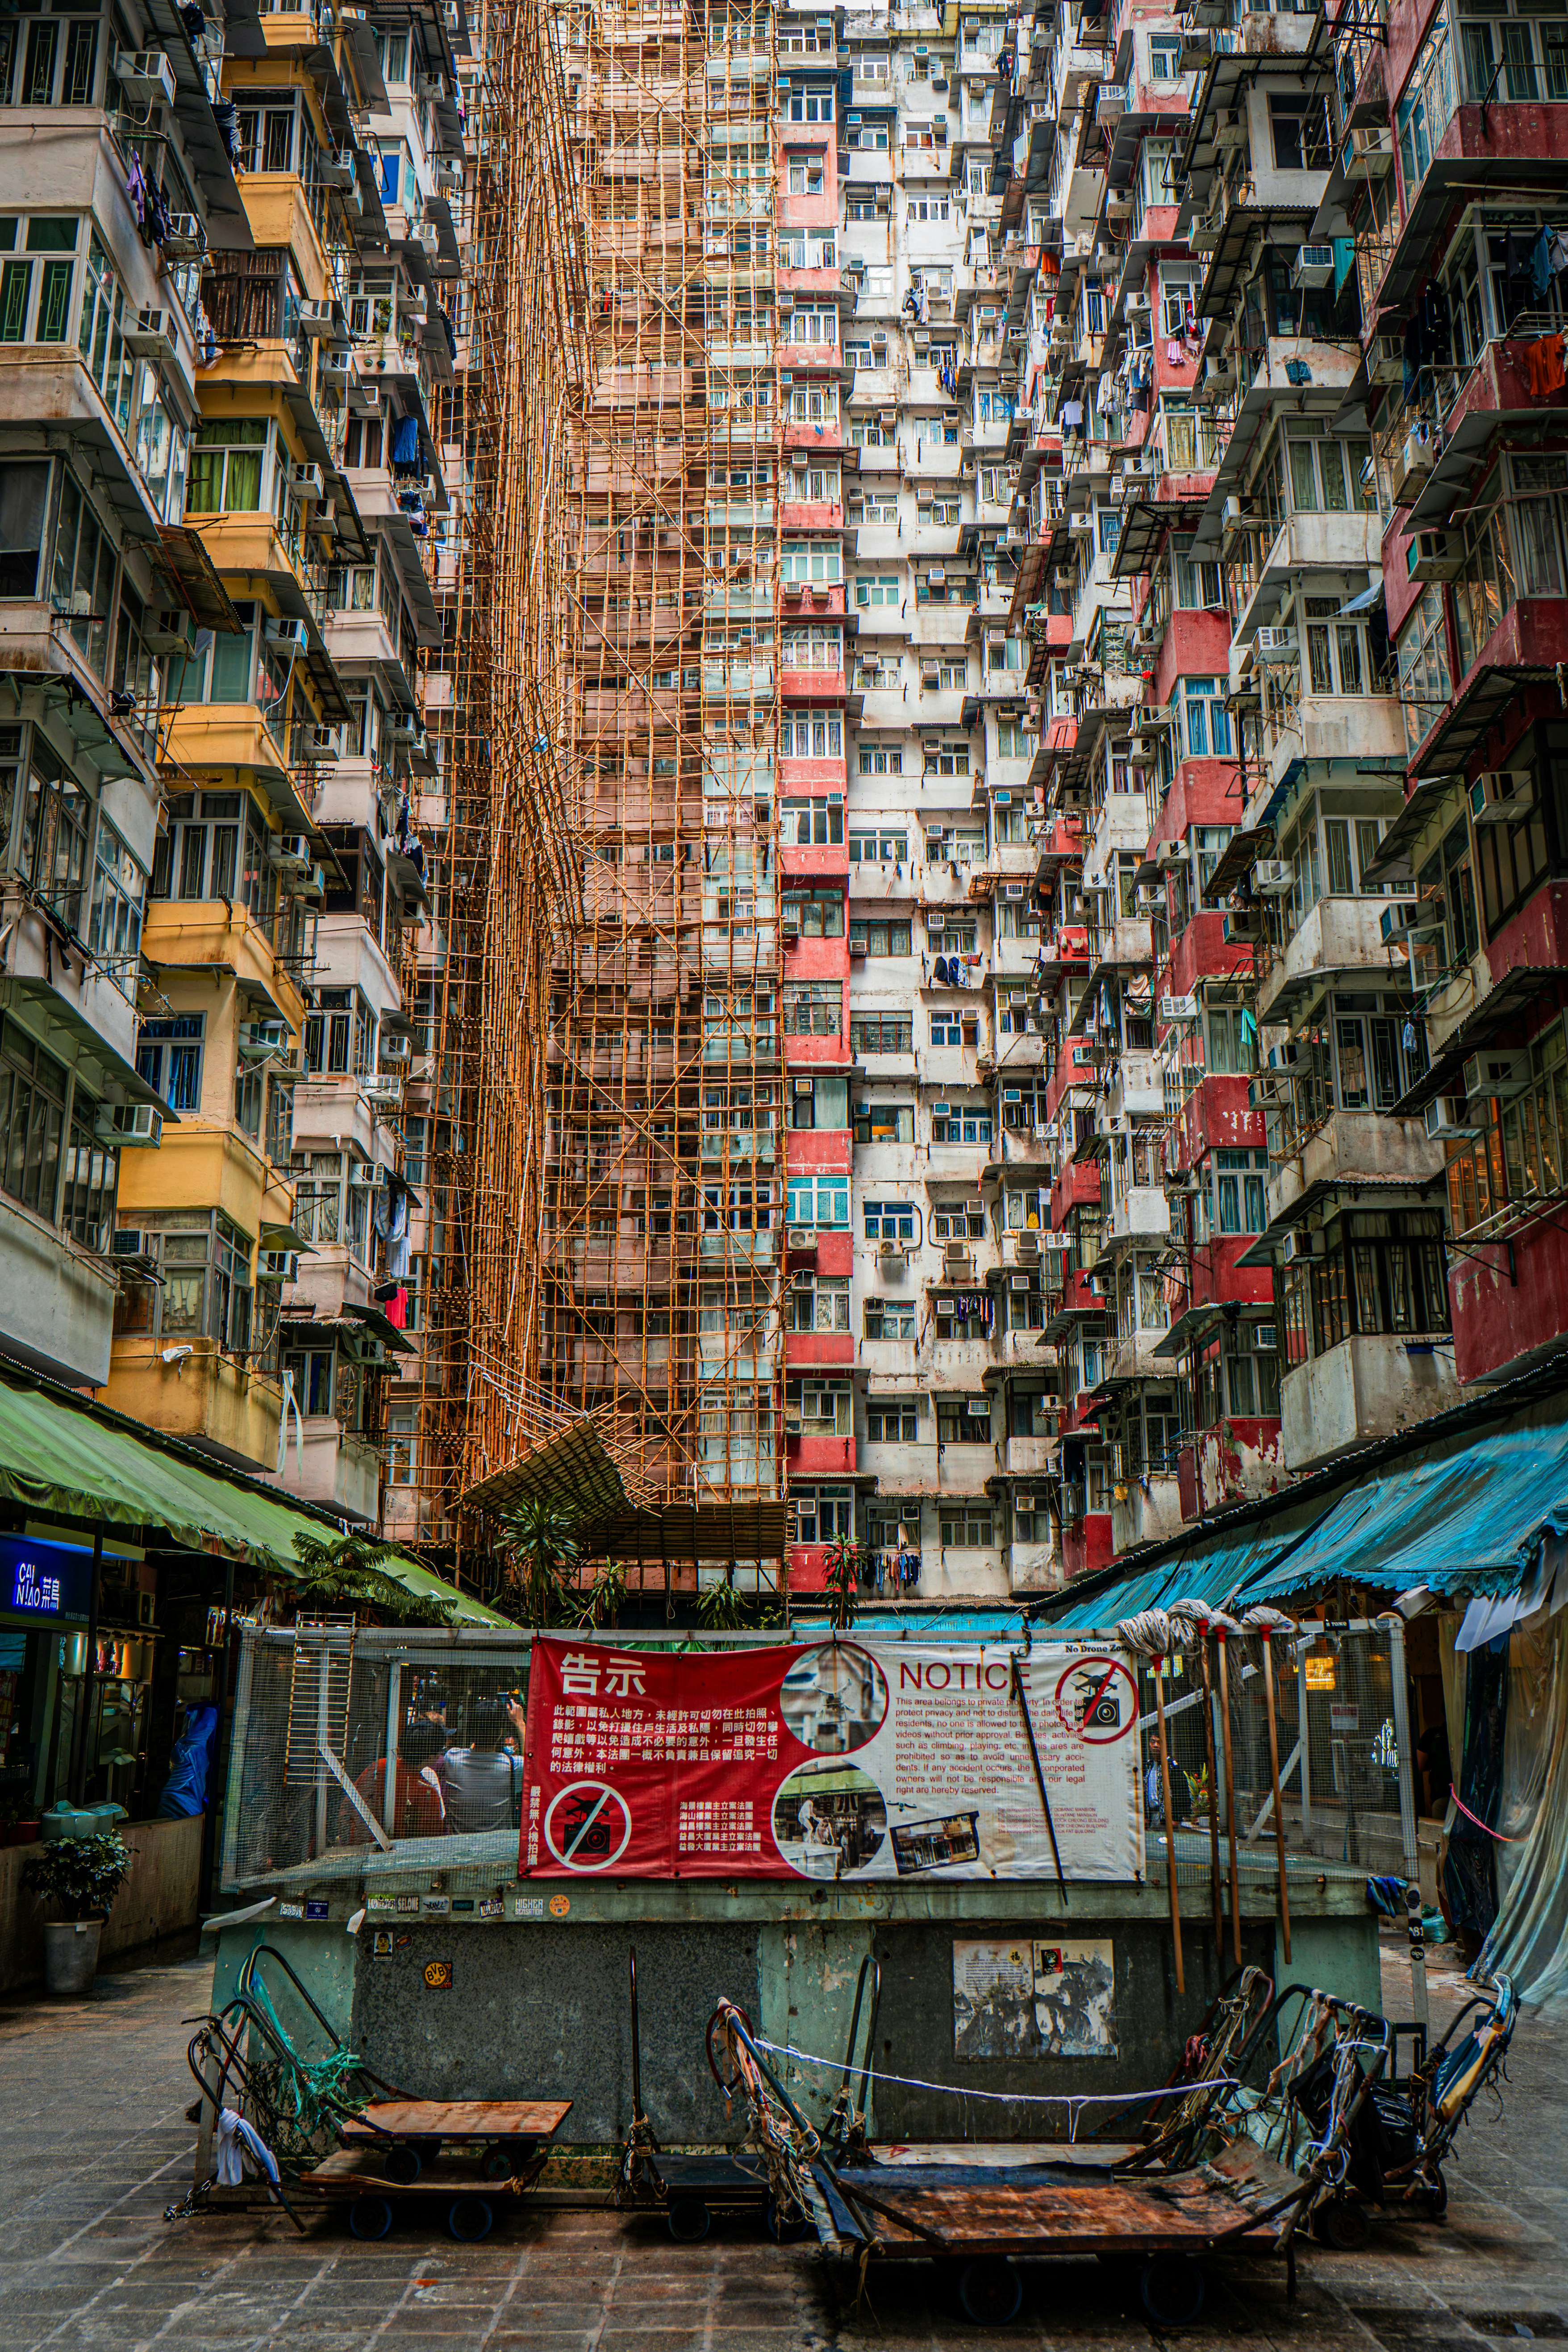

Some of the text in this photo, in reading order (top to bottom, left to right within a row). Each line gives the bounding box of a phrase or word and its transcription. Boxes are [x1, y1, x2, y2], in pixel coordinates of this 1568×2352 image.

[19, 1563, 35, 1585] CAI
[559, 1652, 647, 1697] 告示
[900, 1662, 1032, 1690] NOTICE
[934, 1698, 966, 1707] belongs
[978, 1698, 1004, 1707] private
[925, 1710, 953, 1718] privacy
[1041, 1710, 1059, 1718] daily
[1039, 1720, 1066, 1729] photos
[955, 1731, 973, 1739] prior
[976, 1731, 1012, 1739] approval.
[1015, 1731, 1049, 1739] Besdes,
[896, 1753, 935, 1761] prohibited
[979, 1775, 1024, 1784] responsible
[1066, 1775, 1085, 1784] legal
[896, 1786, 914, 1795] right
[931, 1786, 959, 1795] hereby
[527, 1785, 541, 1866] 嚴禁無人機拍攝
[515, 1898, 543, 1908] HIGHER
[1010, 1951, 1020, 1961] 福
[426, 1964, 445, 1981] BVB
